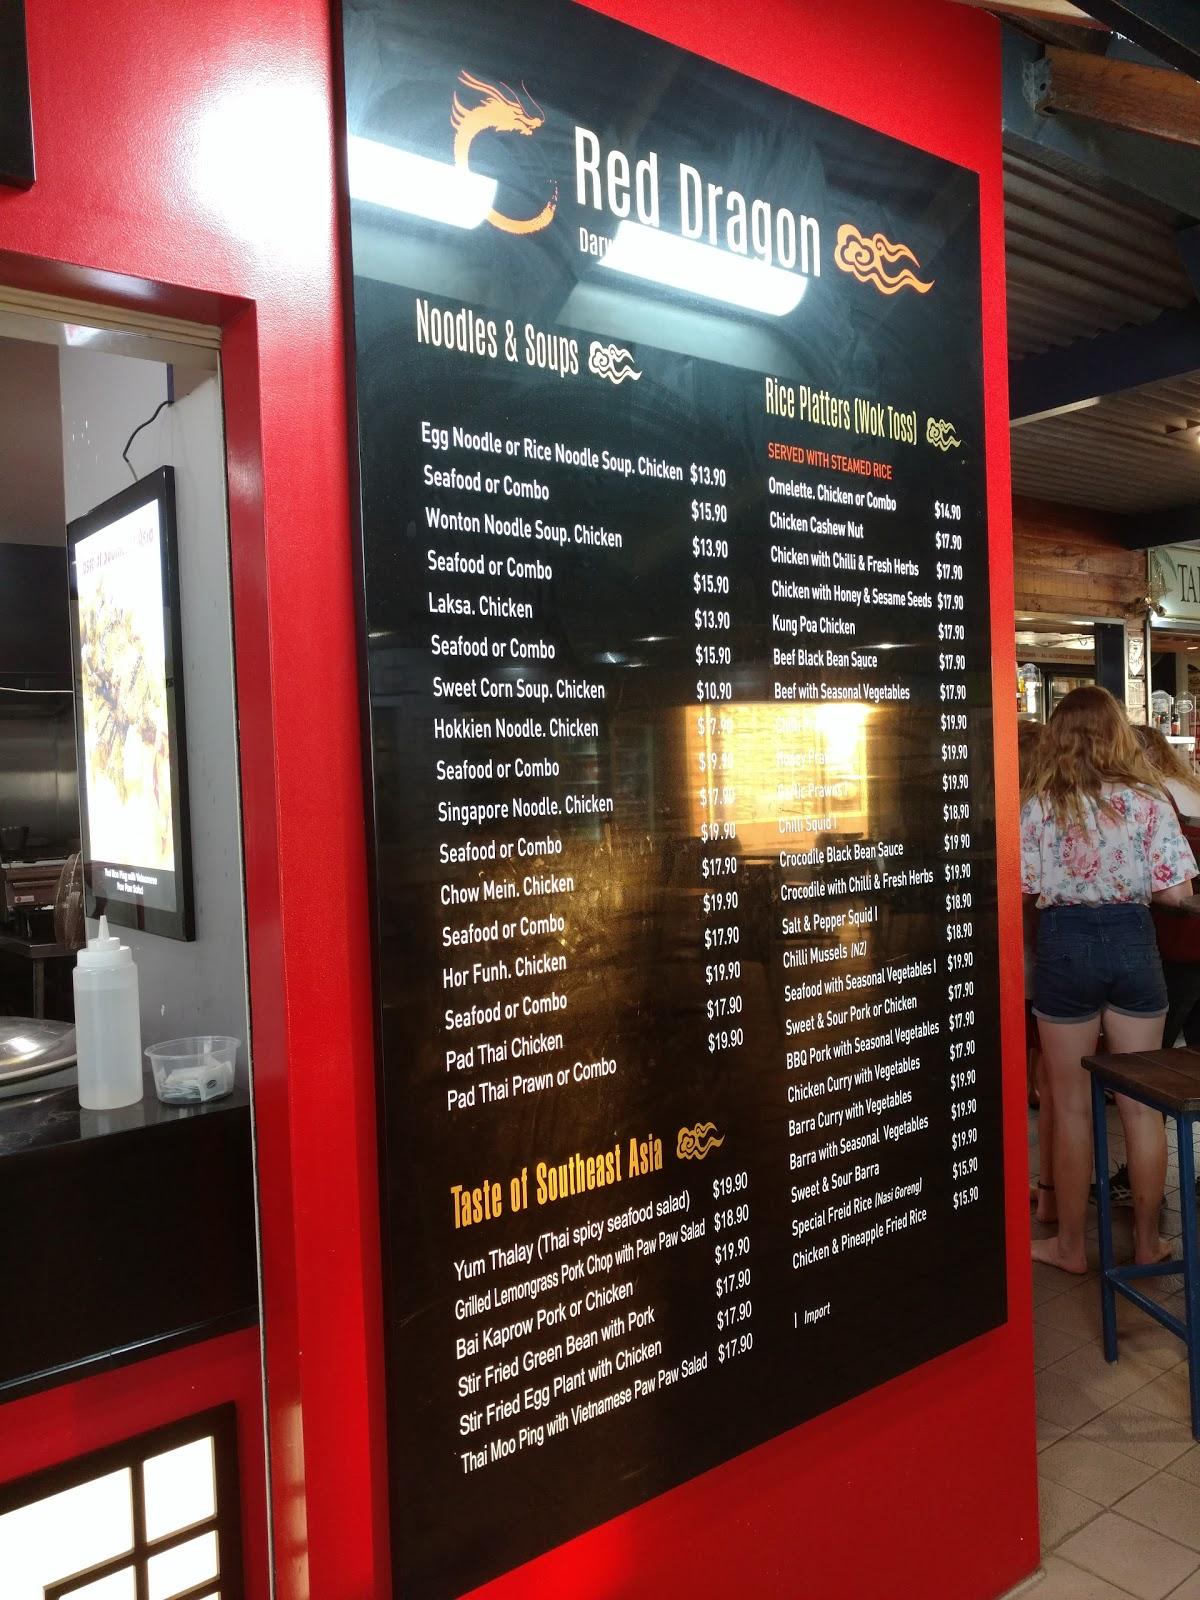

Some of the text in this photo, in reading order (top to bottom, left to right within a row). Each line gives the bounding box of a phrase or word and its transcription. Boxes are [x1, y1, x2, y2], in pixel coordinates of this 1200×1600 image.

[575, 126, 821, 277] Red Dragon
[416, 298, 579, 377] Noodles & Soups
[765, 377, 917, 445] Rice Platters (Wok Toss)
[421, 421, 449, 451] Egg
[452, 426, 502, 454] Noodle
[506, 440, 521, 456] or
[524, 438, 552, 461] Rice
[555, 443, 599, 468] Noodle
[638, 456, 683, 481] Chicken
[690, 462, 726, 487] $13.90
[768, 442, 892, 480] SERVED WITH STEAMED RICE
[424, 464, 727, 523] Seafood or Combo $15.90
[817, 484, 853, 505] Chicken
[855, 494, 865, 506] or
[866, 492, 896, 511] Combo
[935, 500, 961, 520] $14.90
[425, 506, 480, 533] Wonton
[484, 513, 532, 538] Noodle
[574, 524, 622, 548] Chicken
[692, 535, 728, 558] $13.90
[770, 511, 962, 551] Chicken Cashew Nut $17.90
[479, 595, 533, 618] Chicken
[694, 608, 730, 630] $13.90
[772, 614, 965, 641] Kung Poa Chicken $17.90
[433, 676, 477, 697] Sweet
[480, 677, 513, 698] Corn
[556, 679, 605, 699] Chicken
[696, 680, 732, 702] $10.90
[434, 718, 491, 739] Hokkien
[550, 718, 598, 737] Chicken
[438, 801, 509, 826] Singapore
[565, 794, 613, 814] Chicken
[441, 884, 480, 905] Chow
[523, 874, 575, 896] Chicken
[702, 856, 737, 879] $17.90
[778, 843, 903, 868] Crocodile Black Bean Sauce
[443, 967, 470, 989] Hor
[515, 955, 567, 977] Chicken
[705, 926, 739, 950] $17.90
[783, 922, 973, 968] Chilli Mussels (NZ) $18.90
[446, 995, 742, 1072] Pad Thai Chicken $17.90
[448, 1028, 744, 1111] Pad Thai Prawn or Combo $19.90
[789, 1069, 976, 1137] Barra Curry with Vegetables $19.90
[451, 1134, 662, 1229] Taste of Southeast Asia
[791, 1128, 977, 1203] Sweet & Sour Barra $19.90
[792, 1157, 978, 1237] Special Freid Rice (Nasi Goreng) $15.90
[454, 1171, 748, 1281] Yum Thalay (Thai spicy seafood salad) $19.90
[793, 1186, 979, 1269] Chicken & Pineapple Fried Rice $15.90
[455, 1204, 749, 1320] Grilled Lemongrass Pork Chop with Paw Paw Salad $18.90
[456, 1236, 750, 1360] Bai Kaprow Pork or Chicken $19.90
[804, 1302, 831, 1324] Import
[458, 1268, 751, 1397] Stir Fried Green Bean with Pork $17.90
[461, 1332, 753, 1474] Thai Moo Ping with Vietnamese Paw Paw Salad $17.90
